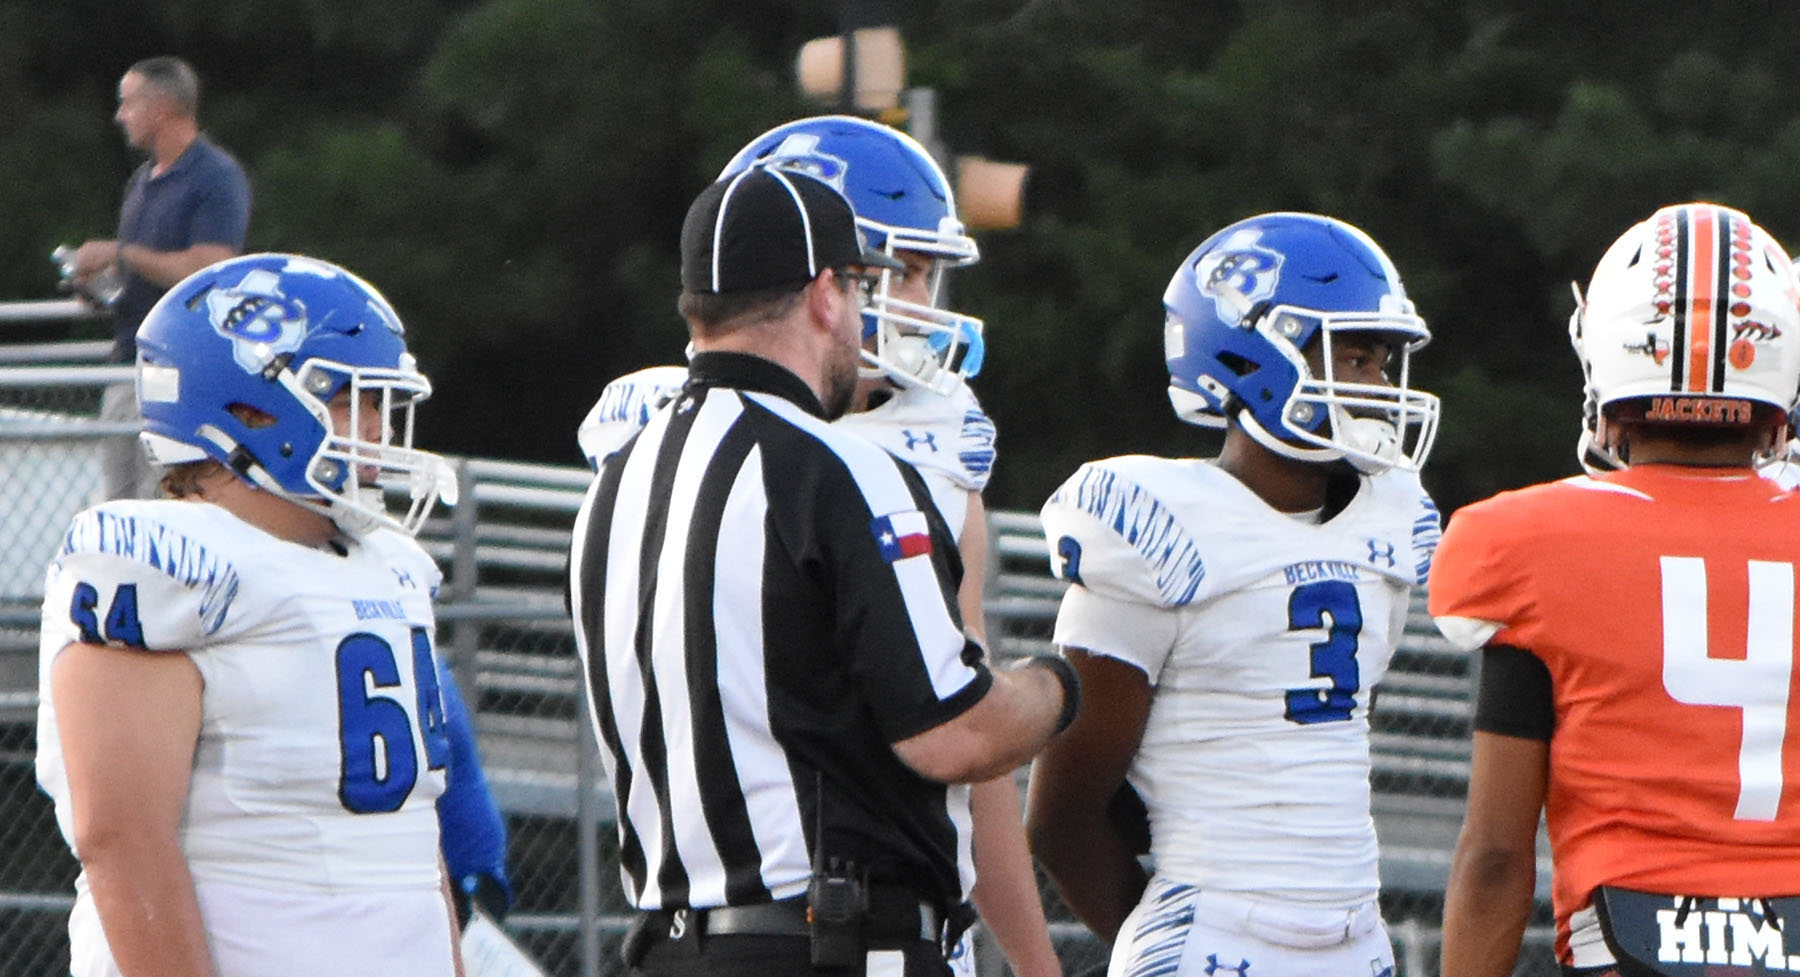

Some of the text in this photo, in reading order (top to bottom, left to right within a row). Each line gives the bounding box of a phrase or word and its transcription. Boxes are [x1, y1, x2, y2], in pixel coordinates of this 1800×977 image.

[1645, 397, 1752, 424] JACKETS
[1284, 560, 1359, 585] BECKVILLE
[336, 626, 446, 815] 64
[1284, 579, 1363, 725] 3
[1660, 556, 1795, 821] 4
